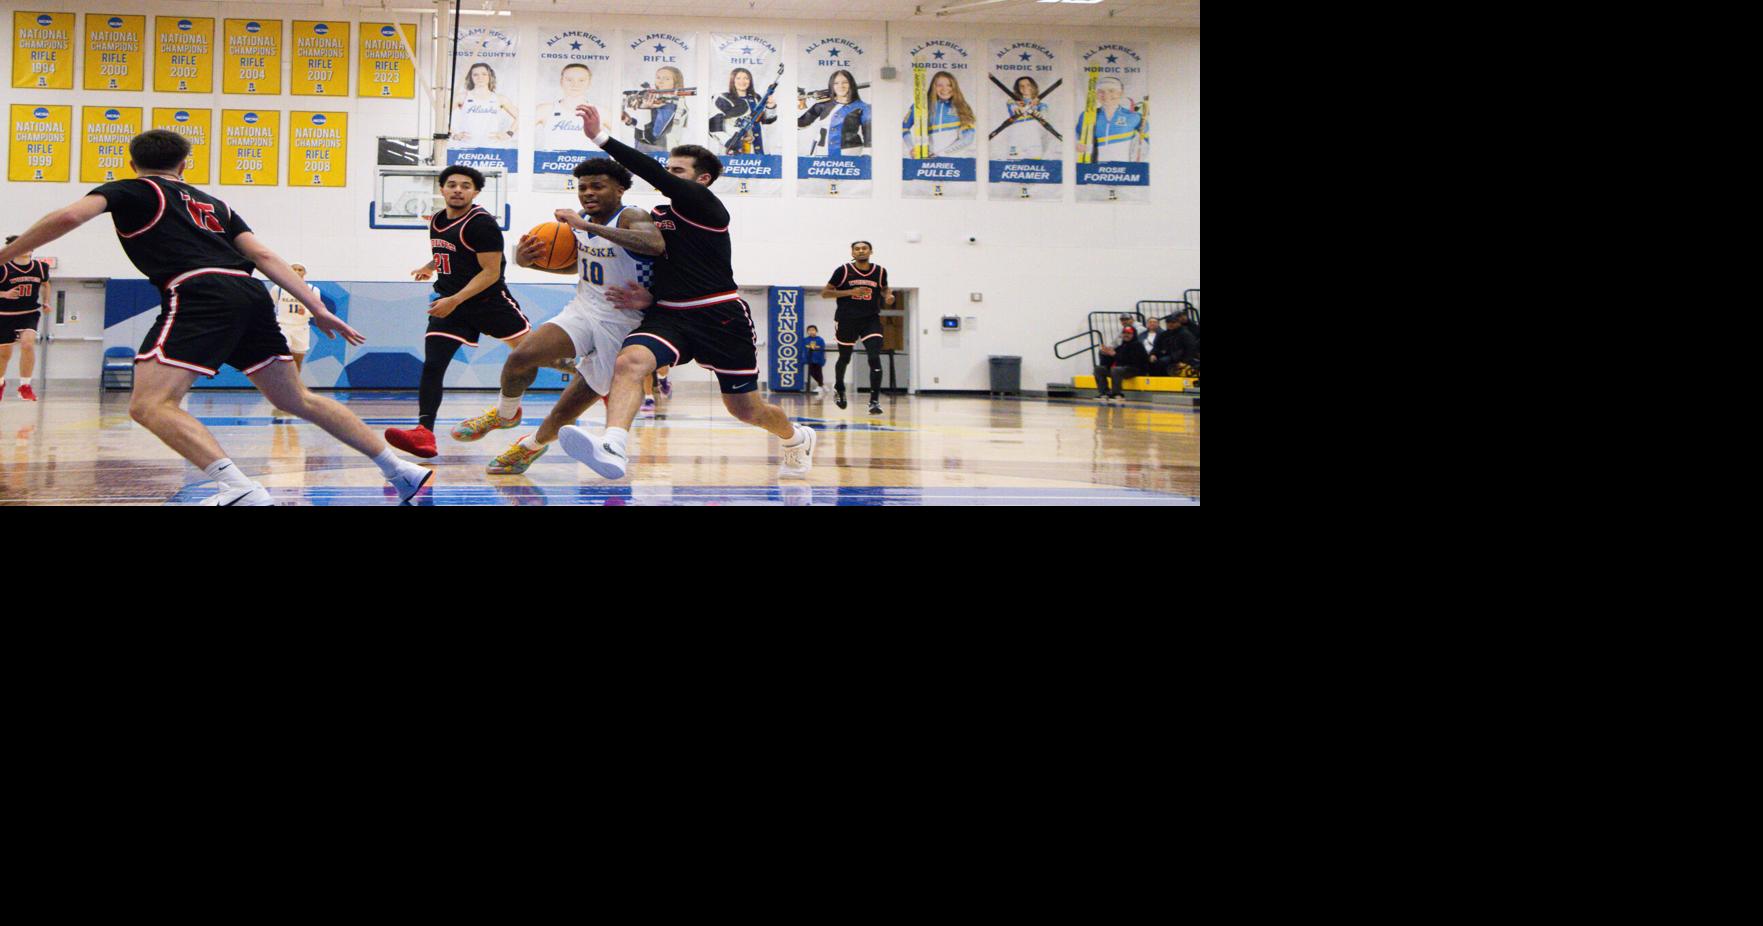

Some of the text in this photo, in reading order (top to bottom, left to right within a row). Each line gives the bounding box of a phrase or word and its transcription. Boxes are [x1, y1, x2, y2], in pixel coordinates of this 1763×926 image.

[20, 29, 68, 40] NATIONAL
[90, 32, 138, 42] NATIONAL
[160, 34, 208, 44] NATIONAL
[20, 40, 67, 49] CHAMPIONS
[230, 36, 276, 46] NATIONAL
[298, 38, 344, 48] NATIONAL
[365, 40, 406, 50] NATIONA
[547, 31, 606, 49] ALL AMERICAN
[630, 33, 689, 51] ALL AMERICAN
[734, 35, 776, 53] AMERICAN
[91, 42, 138, 52] CHAMPIONS
[160, 44, 208, 54] CHAMPIONS
[805, 37, 864, 55] ALL AMERICAN
[910, 40, 968, 57] ALL AMERICAN
[997, 42, 1054, 60] ALL AMERICAN
[31, 51, 56, 61] RIFLE
[230, 47, 276, 56] CHAMPIONS
[298, 48, 344, 58] CHAMPIONS
[1082, 44, 1141, 62] ALL AMERICAN
[102, 53, 127, 63] RIFLE
[171, 56, 196, 65] RIFLE
[240, 58, 265, 67] RIFLE
[818, 59, 850, 67] RIFLE
[32, 63, 55, 73] 1994
[308, 59, 332, 69] RIFLE
[375, 61, 399, 70] RIFLE
[101, 65, 128, 76] 2000
[170, 67, 197, 78] 2002
[240, 69, 265, 80] 2004
[308, 71, 333, 81] 2007
[373, 72, 400, 83] 2023
[16, 122, 65, 132] NATIONAL
[87, 124, 136, 134] NATIONAL
[227, 127, 273, 137] NATIONAL
[16, 133, 64, 142] CHAMPIONS
[295, 128, 341, 139] NATIONAL
[227, 137, 273, 147] CHAMPIONS
[295, 139, 341, 148] CHAMPIONS
[27, 144, 53, 154] RIFLE
[99, 146, 124, 155] RIFLE
[237, 148, 262, 158] RIFLE
[306, 150, 329, 159] RIFLE
[27, 155, 52, 167] 1999
[98, 157, 124, 168] 2001
[236, 160, 262, 171] 2006
[305, 161, 330, 172] 2008
[542, 162, 577, 171] FORD
[808, 167, 860, 176] CHARLES
[917, 169, 961, 177] PULLES
[1001, 171, 1050, 180] KRAMER
[1084, 173, 1140, 182] FORDHAM
[433, 253, 452, 275] 21
[581, 258, 604, 286] 10
[18, 284, 33, 297] 11
[289, 304, 298, 313] 11
[778, 289, 798, 388] NANOOKS
